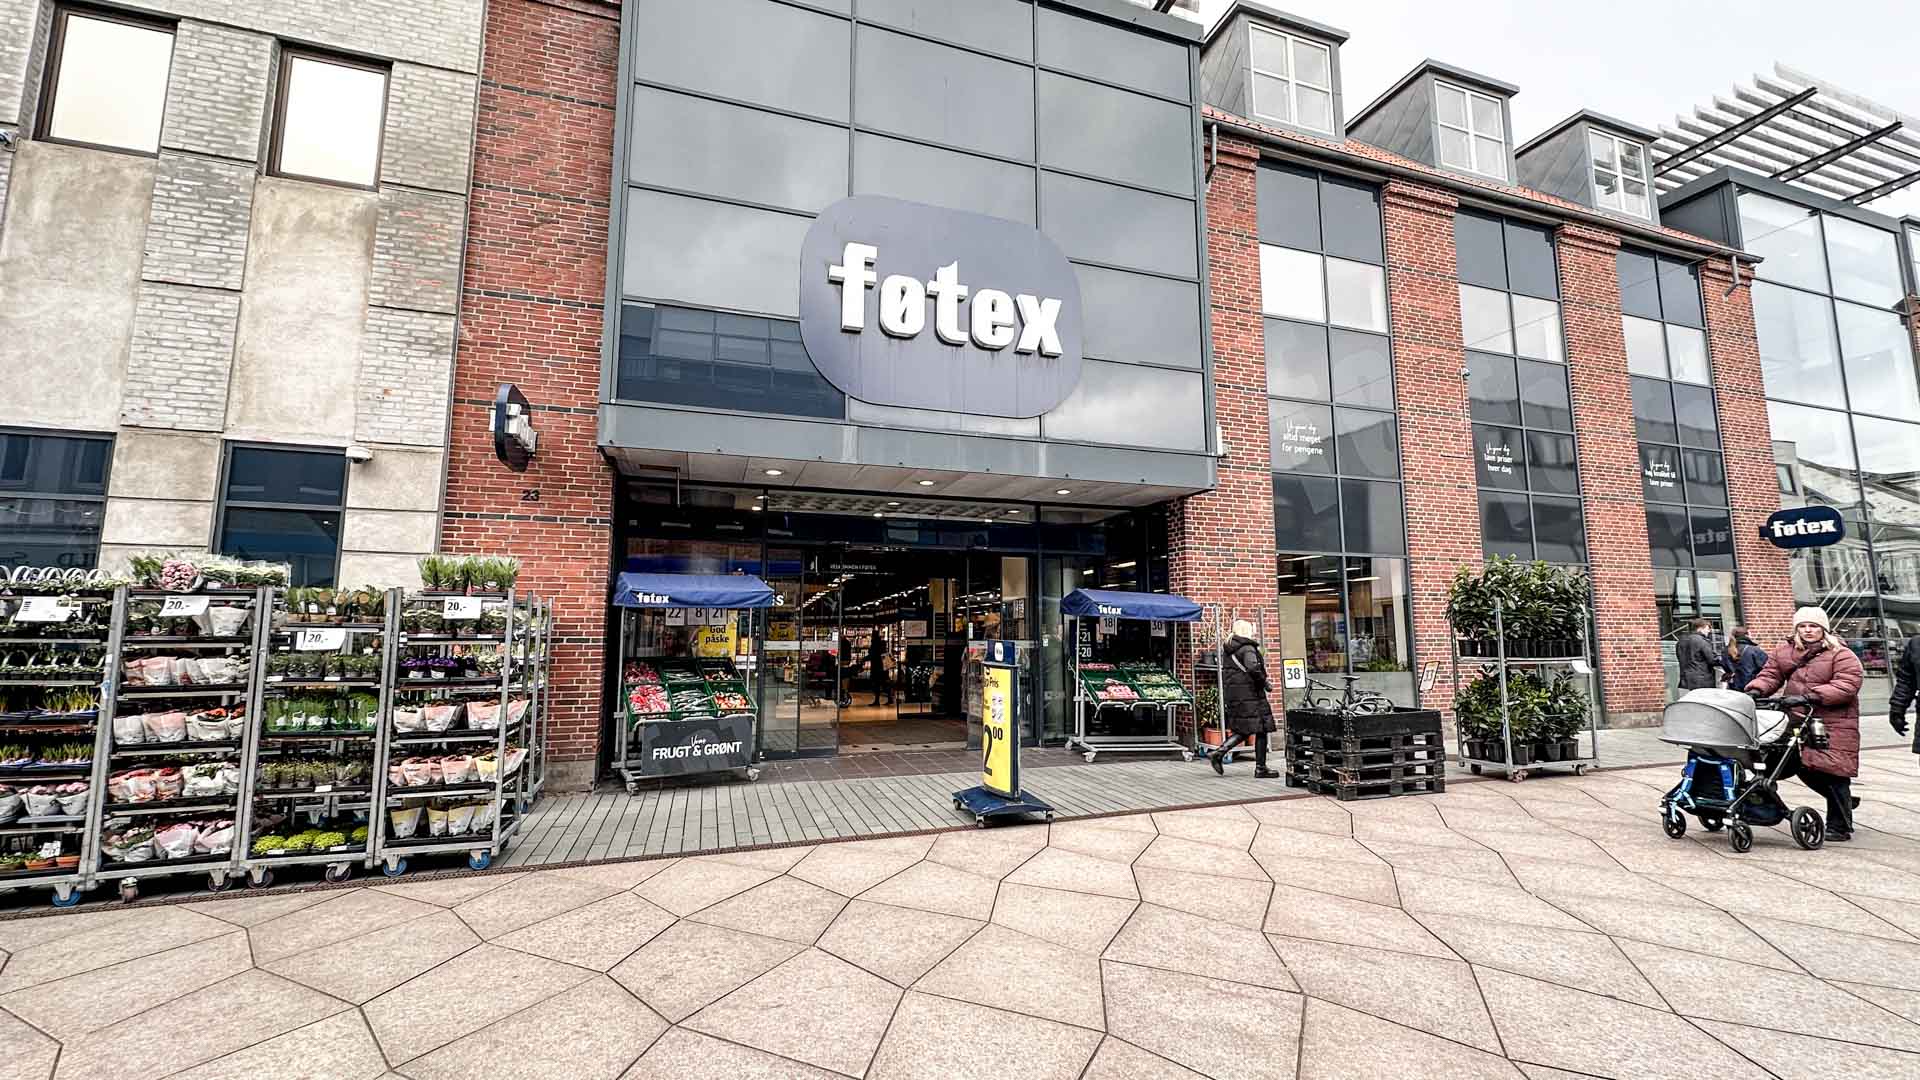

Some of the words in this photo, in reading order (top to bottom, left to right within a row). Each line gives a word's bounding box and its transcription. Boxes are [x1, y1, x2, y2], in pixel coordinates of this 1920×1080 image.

[828, 242, 1063, 357] føtex
[1281, 442, 1292, 452] for
[1294, 446, 1323, 456] pengene
[521, 489, 540, 501] 23
[1771, 518, 1837, 538] føtex
[1286, 667, 1301, 680] 38
[652, 745, 691, 760] FRUGT
[692, 745, 701, 756] &
[704, 741, 742, 755] GRØNT
